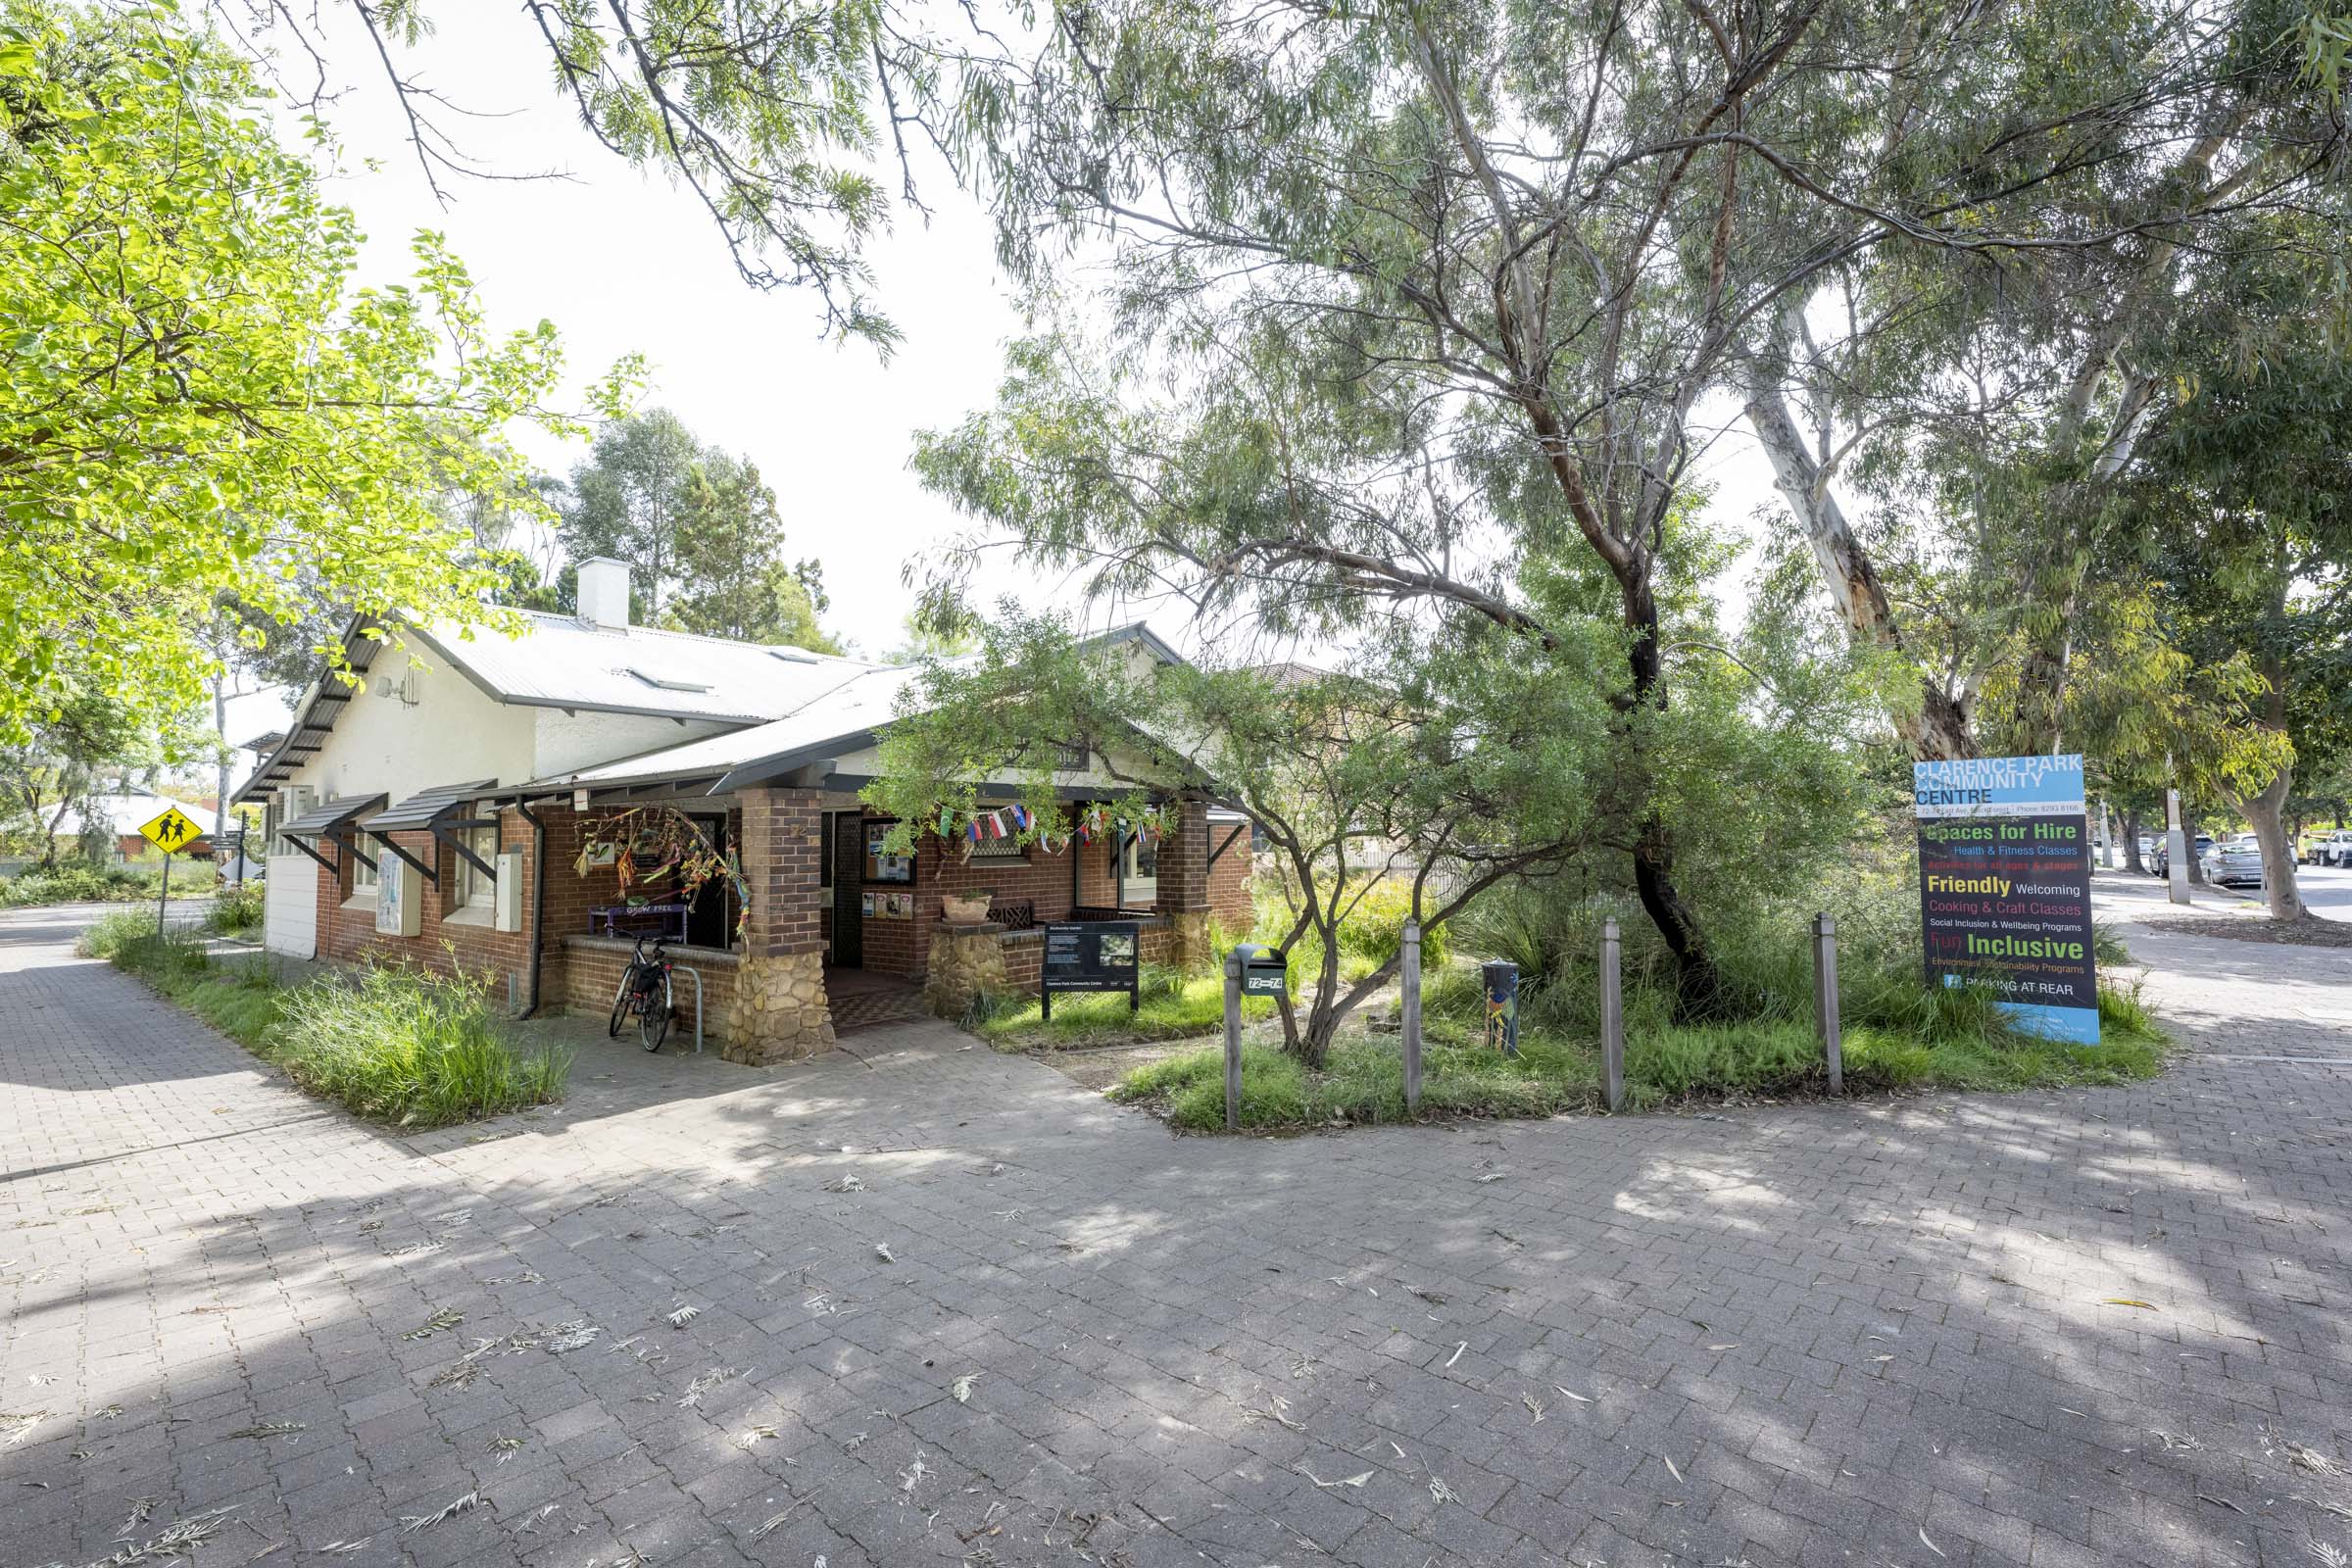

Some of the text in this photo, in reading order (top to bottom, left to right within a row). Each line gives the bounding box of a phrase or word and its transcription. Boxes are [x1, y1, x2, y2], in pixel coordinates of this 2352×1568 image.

[1914, 756, 2082, 777] CLARENCE PARK
[1916, 771, 2043, 791] COMMUNITY
[1916, 789, 1992, 806] CENTRE
[1927, 822, 2077, 843] Spaces for Hire
[1954, 846, 2078, 856] Health & Fitness Classes
[1928, 875, 2081, 898] Friendly Welcoming
[1930, 900, 2082, 915] Cooking & Craft Classes
[1930, 918, 1952, 927] Social
[1955, 919, 1989, 929] Inclusion
[2000, 920, 2040, 931] Wellbeing
[2042, 923, 2082, 932] Programs
[1931, 932, 2084, 960] Fun Inclusive
[1932, 957, 2084, 974] Environment Sustainability Programs
[1966, 977, 2017, 991] PARKING
[2021, 981, 2036, 993] AT
[2039, 983, 2074, 996] REAR
